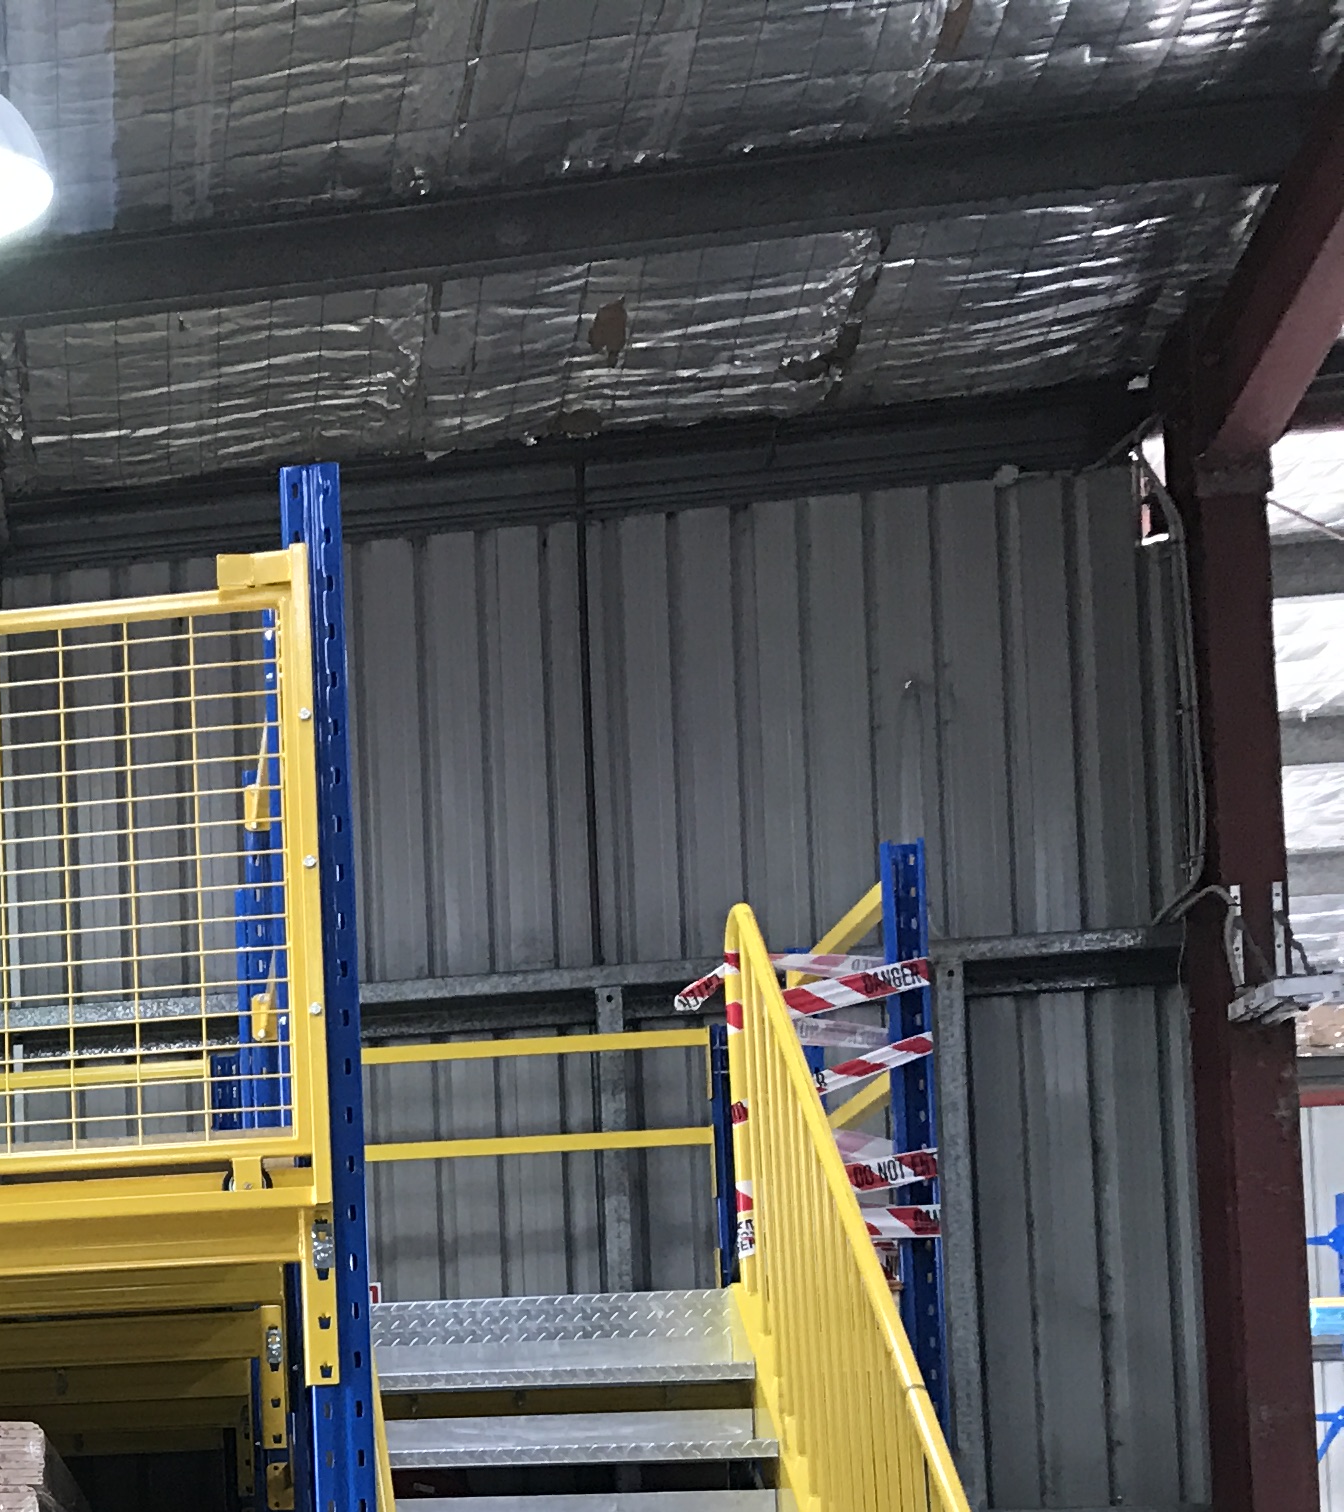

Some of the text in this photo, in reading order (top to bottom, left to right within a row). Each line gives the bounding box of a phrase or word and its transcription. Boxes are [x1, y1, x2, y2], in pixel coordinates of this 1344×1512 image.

[863, 964, 922, 994] DANGER
[853, 1165, 874, 1188] DO
[877, 1158, 906, 1182] NOT
